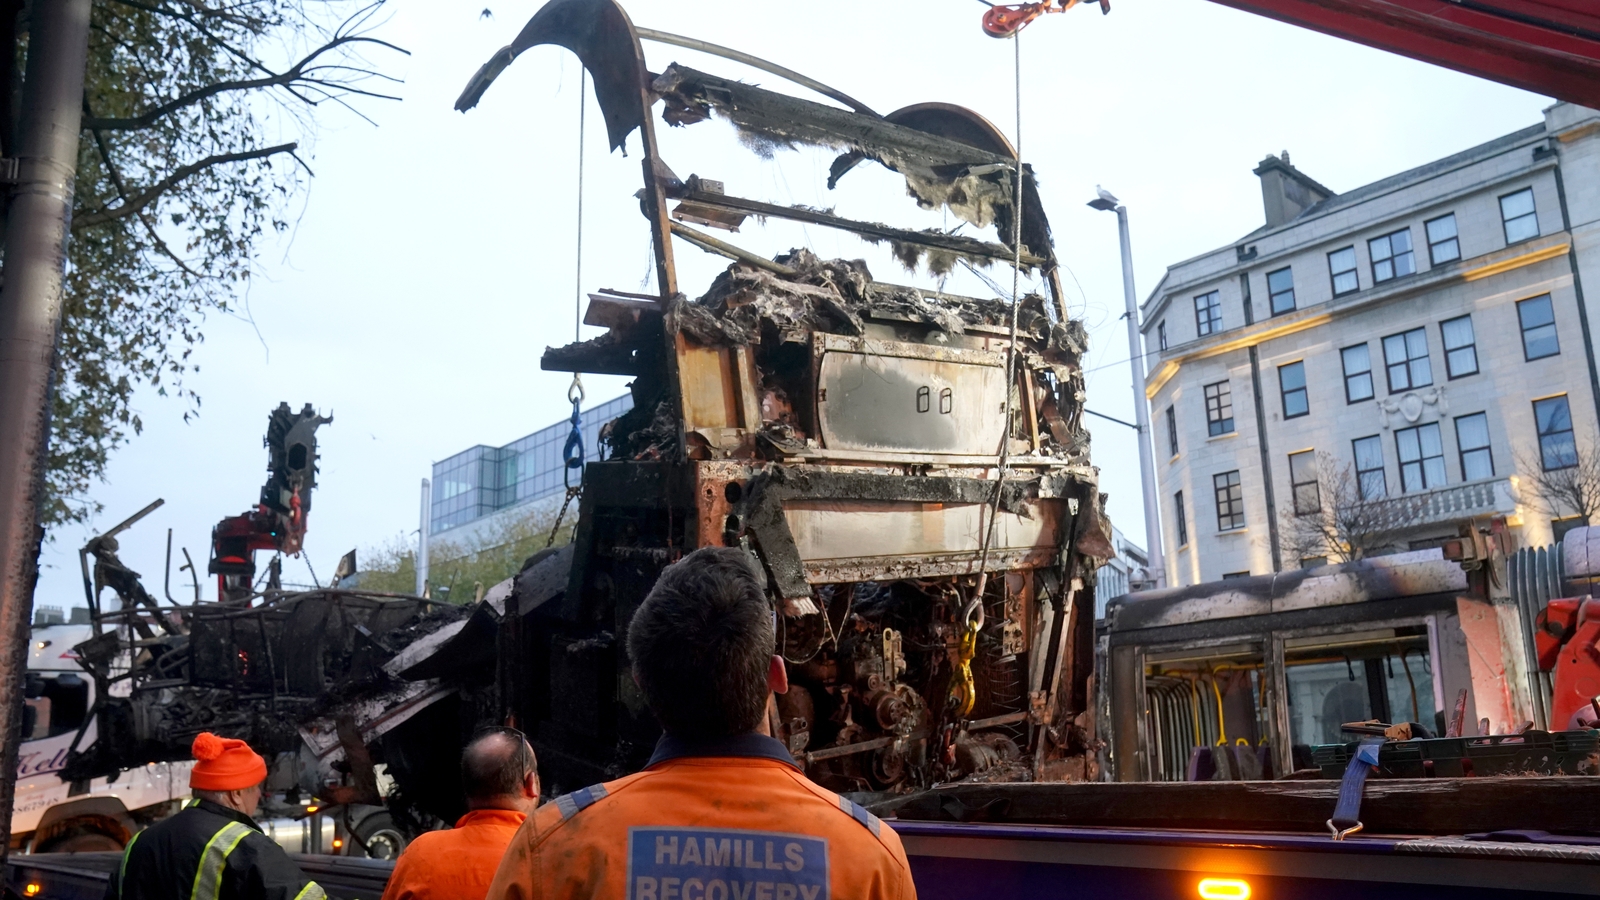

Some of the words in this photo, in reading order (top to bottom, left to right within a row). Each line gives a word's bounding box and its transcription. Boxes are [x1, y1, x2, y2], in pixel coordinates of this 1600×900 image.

[17, 748, 69, 775] Kell
[655, 835, 804, 872] HAMILLS
[635, 876, 821, 900] RECOVERY
